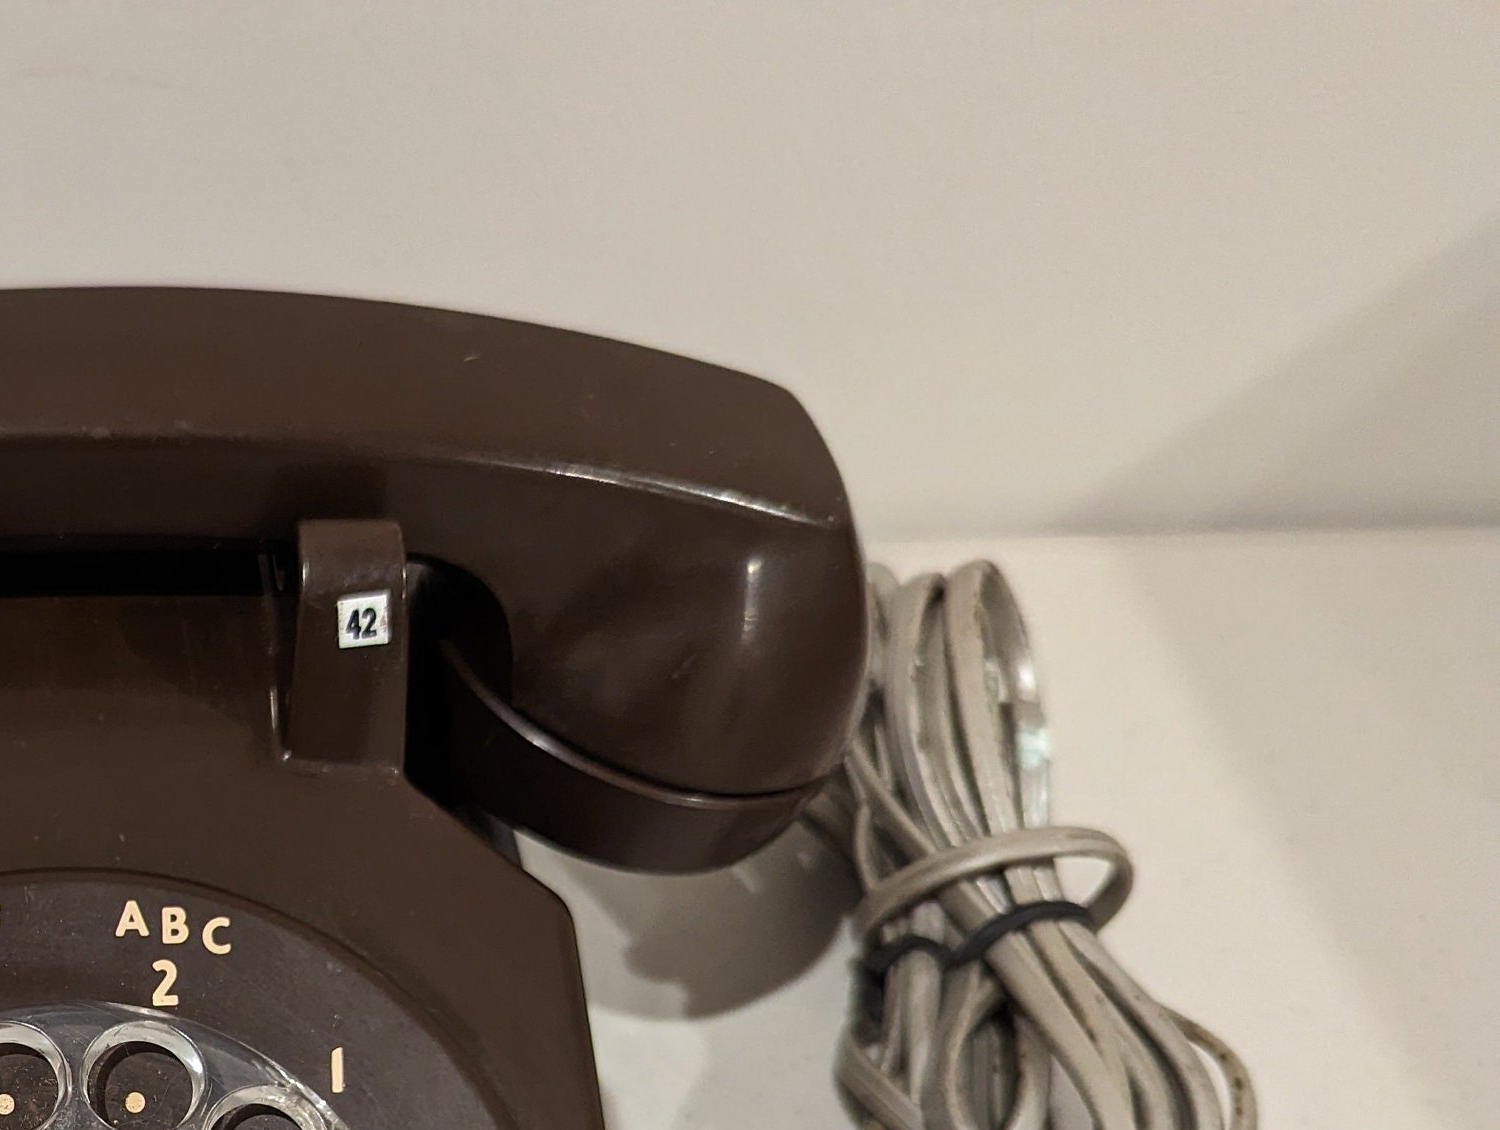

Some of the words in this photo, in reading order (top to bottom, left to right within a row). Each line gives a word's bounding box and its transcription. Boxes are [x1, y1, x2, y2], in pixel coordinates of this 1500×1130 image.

[345, 606, 378, 641] 42
[115, 900, 232, 955] ABC
[152, 959, 179, 1007] 2
